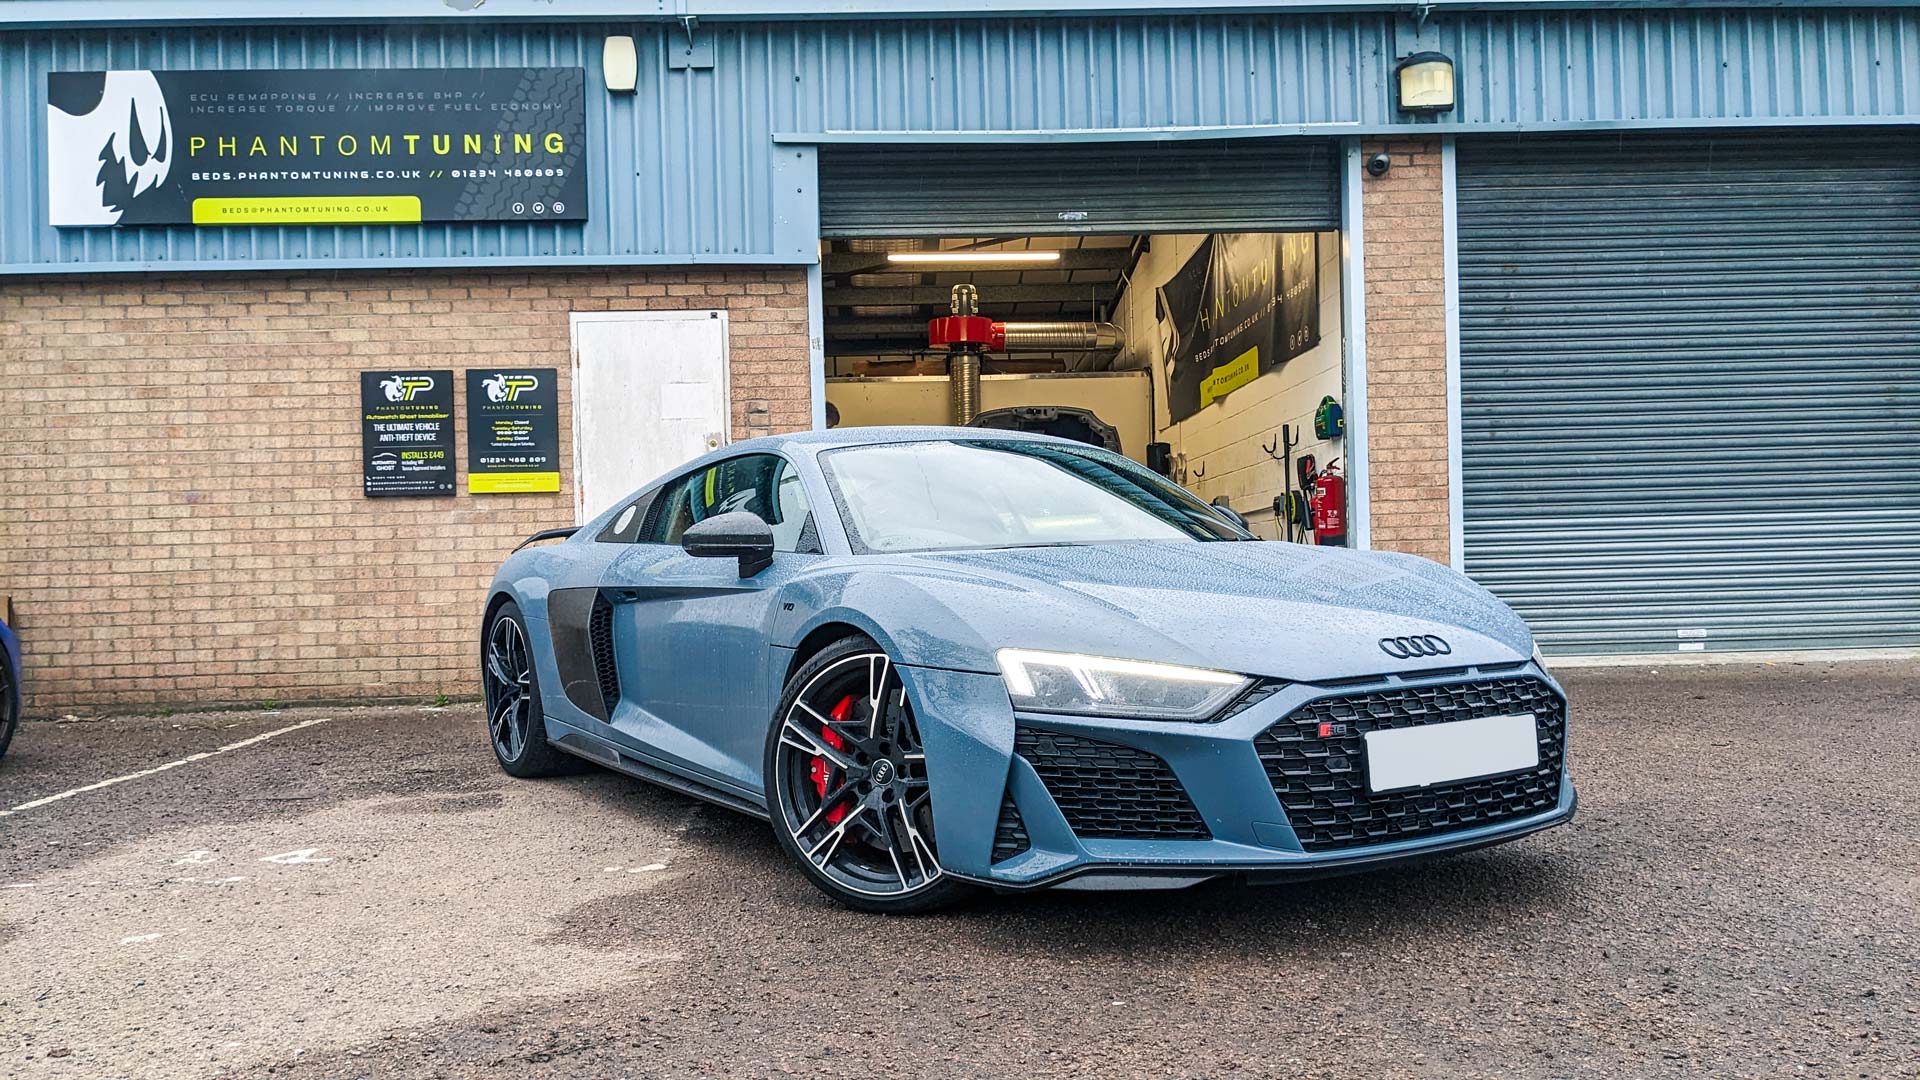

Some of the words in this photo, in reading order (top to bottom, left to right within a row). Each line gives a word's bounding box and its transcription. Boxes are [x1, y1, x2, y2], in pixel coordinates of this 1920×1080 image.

[190, 93, 218, 102] ECU
[228, 92, 316, 101] REMAPPING
[349, 92, 425, 100] INCREASE
[434, 91, 463, 99] BHP
[190, 105, 267, 114] INCREASE
[275, 104, 336, 113] TORQUE
[368, 103, 435, 112] IMPROVE
[444, 103, 482, 112] FUEL
[491, 102, 562, 111] ECONOMY
[191, 170, 421, 181] BEDS.PHANTOMTUNING.CO.UK
[451, 169, 497, 178] 01234
[504, 168, 564, 177] 480809
[222, 205, 389, 214] BEDS@PHANTOMTUNING.CO.UK
[373, 424, 386, 432] THE
[386, 423, 414, 431] ULTIMATE
[415, 422, 440, 431] VEHICLE
[379, 433, 414, 442] ANTI-THEFT
[414, 433, 437, 441] DEVICE
[401, 451, 428, 459] INSTALLS
